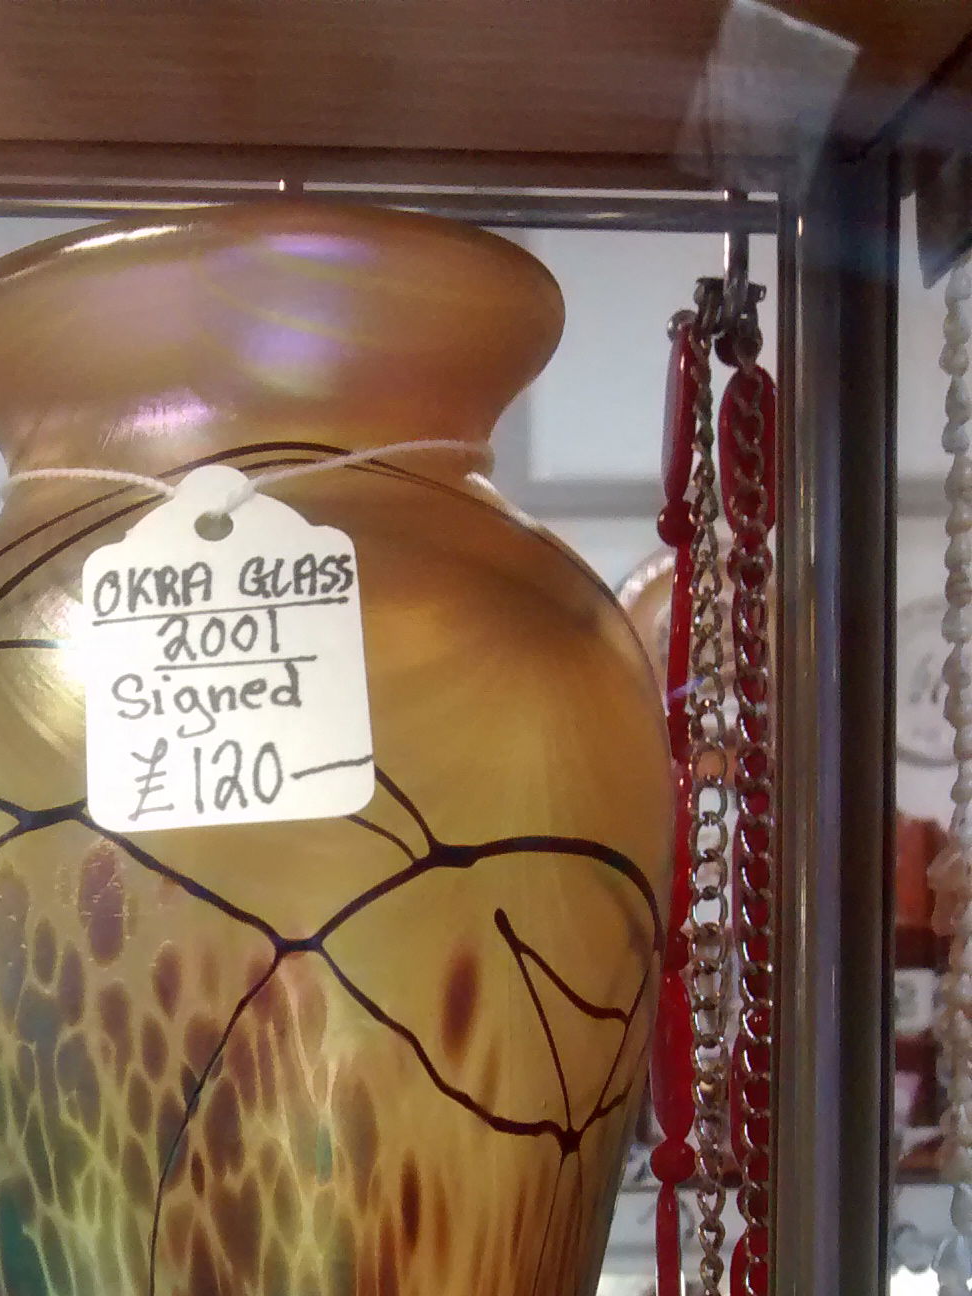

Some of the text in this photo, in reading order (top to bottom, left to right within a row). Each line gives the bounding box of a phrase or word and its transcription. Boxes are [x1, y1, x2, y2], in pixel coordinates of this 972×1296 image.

[93, 553, 354, 617] OKRA GLASS
[156, 605, 280, 661] 2001
[111, 661, 302, 738] Signed
